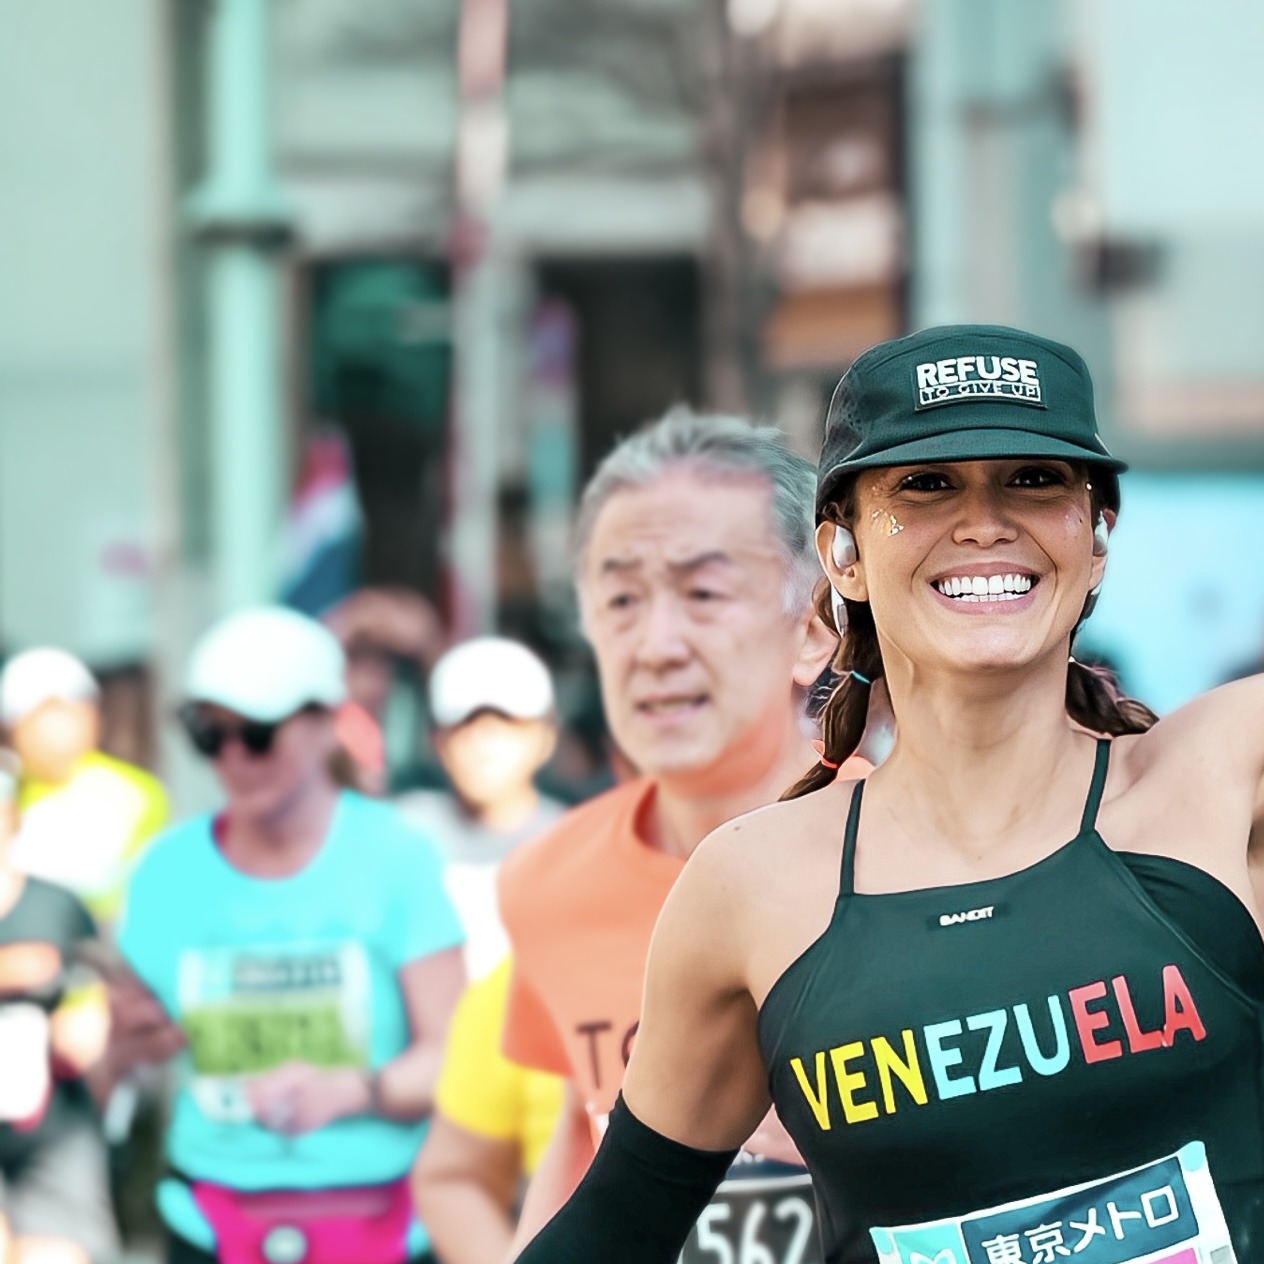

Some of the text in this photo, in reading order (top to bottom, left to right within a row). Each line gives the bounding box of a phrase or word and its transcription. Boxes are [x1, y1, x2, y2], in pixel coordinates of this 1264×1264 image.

[916, 355, 1040, 389] REFUSE
[922, 382, 1037, 400] TO GIVE UP
[939, 906, 994, 926] BANDIT
[790, 964, 1206, 1131] VENEZUELA
